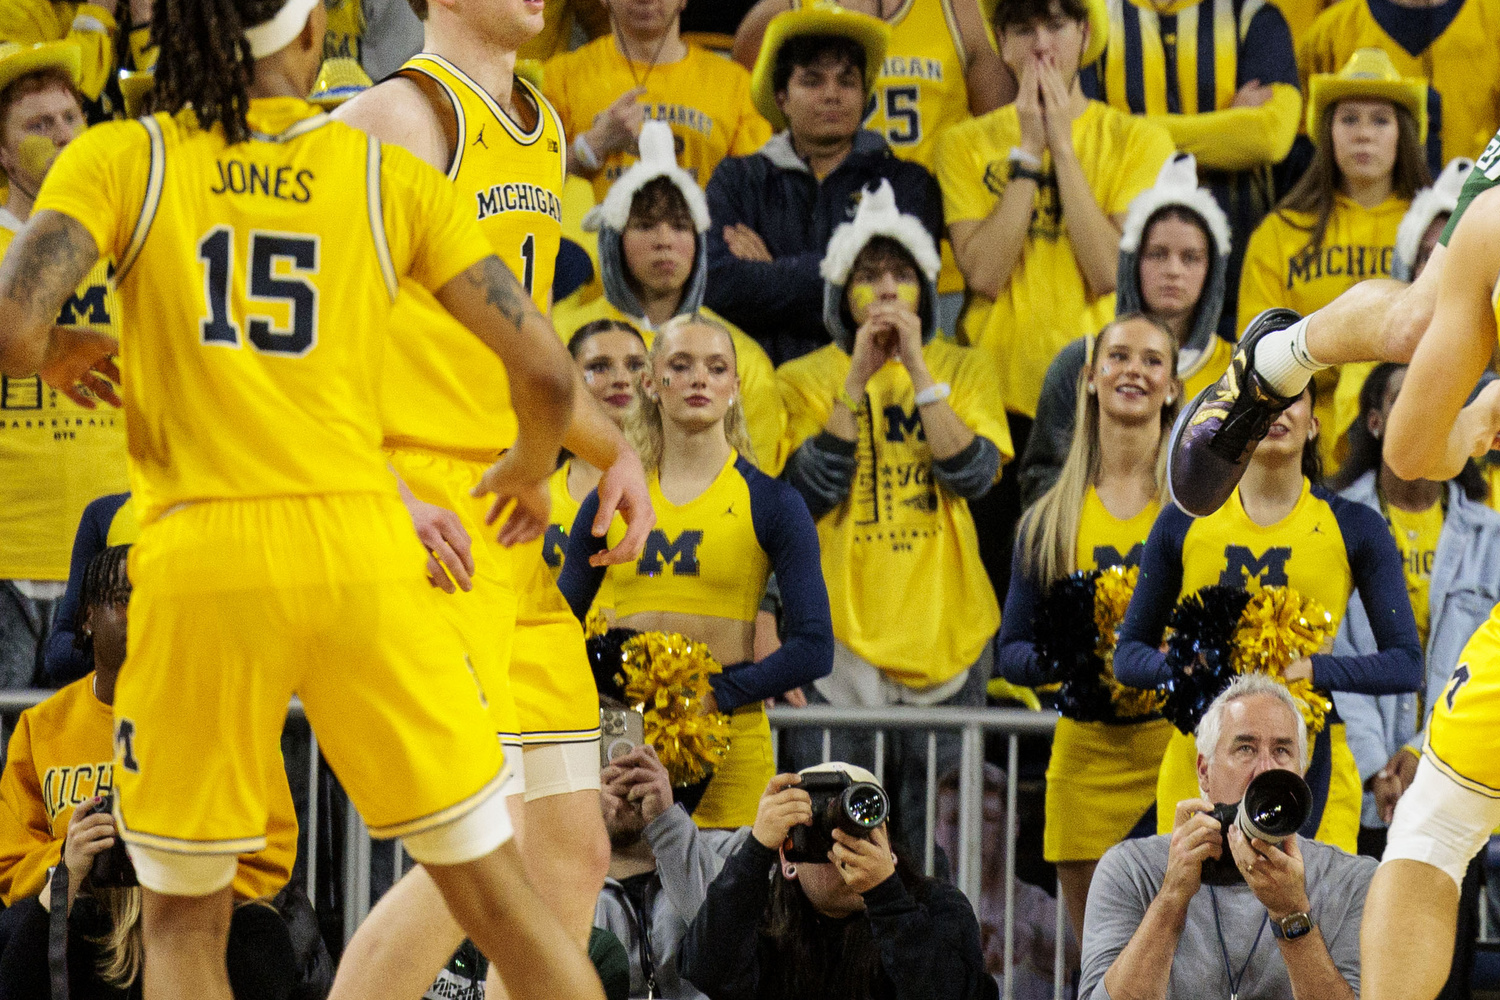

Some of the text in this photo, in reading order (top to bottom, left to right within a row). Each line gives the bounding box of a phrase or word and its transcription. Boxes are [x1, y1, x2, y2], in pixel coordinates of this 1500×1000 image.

[211, 159, 315, 204] JONES
[520, 232, 536, 297] 1
[55, 285, 111, 326] M
[197, 223, 320, 359] 15
[637, 530, 704, 576] M
[1218, 545, 1292, 588] M
